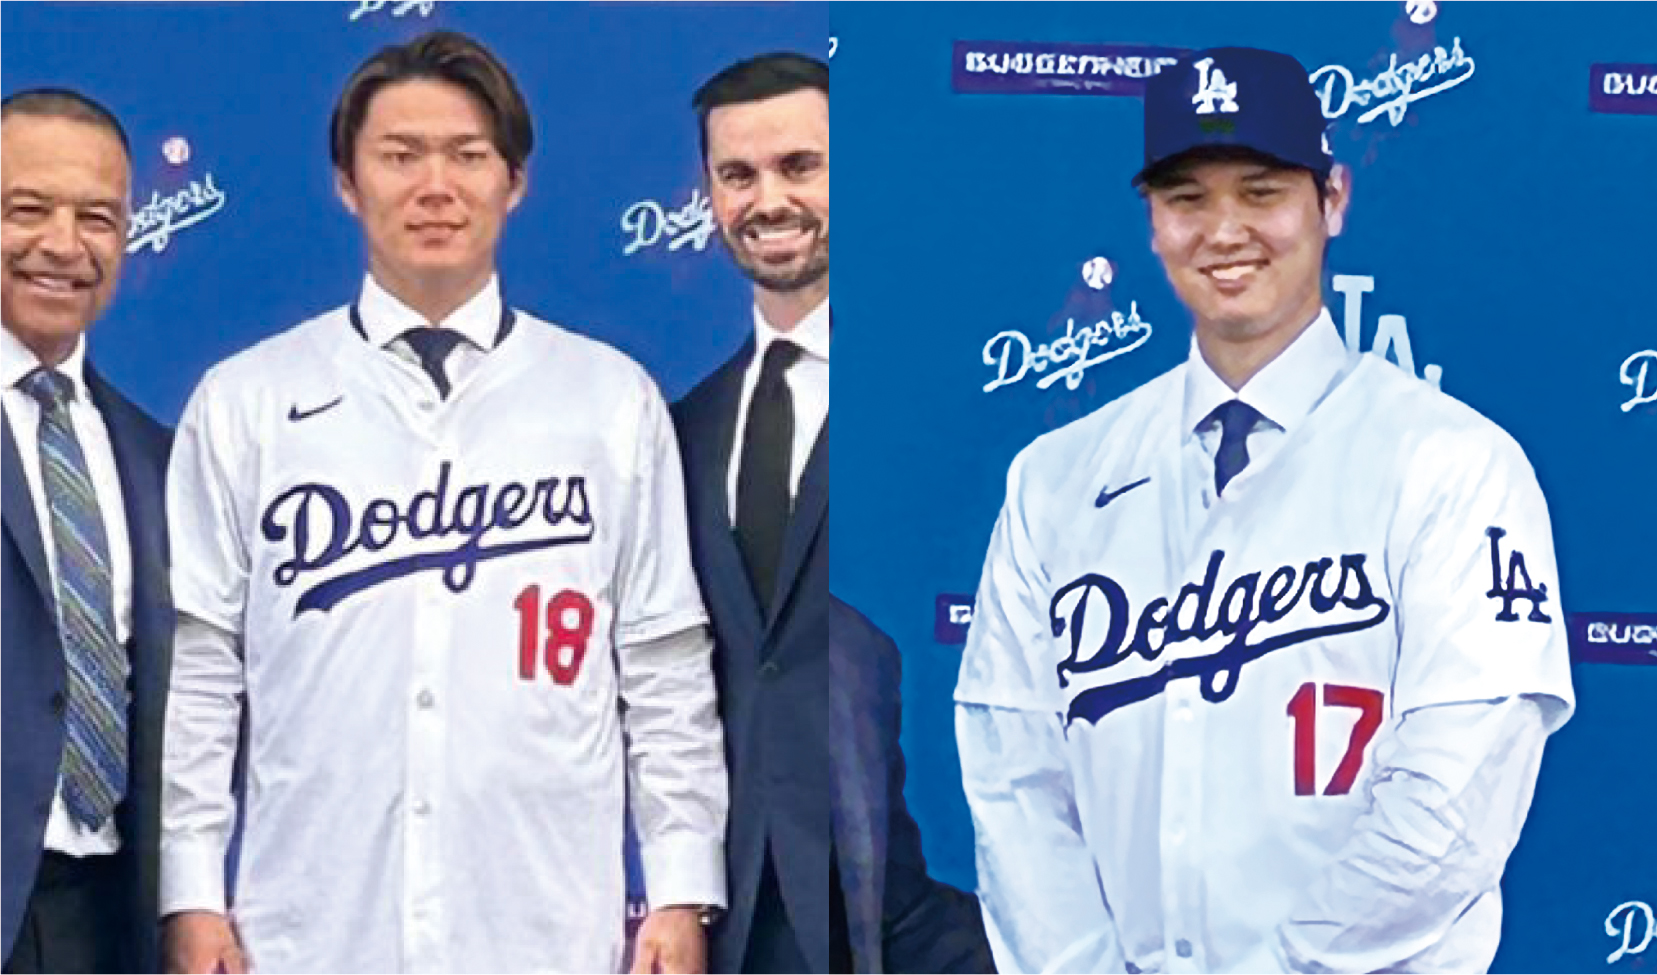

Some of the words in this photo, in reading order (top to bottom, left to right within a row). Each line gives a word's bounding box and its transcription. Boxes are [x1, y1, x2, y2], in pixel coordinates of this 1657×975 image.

[1192, 57, 1239, 114] LA
[1308, 36, 1475, 127] Dodgers
[982, 300, 1153, 392] Dodgers
[261, 460, 594, 621] Dodgers
[1485, 525, 1552, 624] LA
[514, 583, 595, 687] 18
[1049, 549, 1390, 726] Dodgers
[1286, 681, 1385, 796] 17
